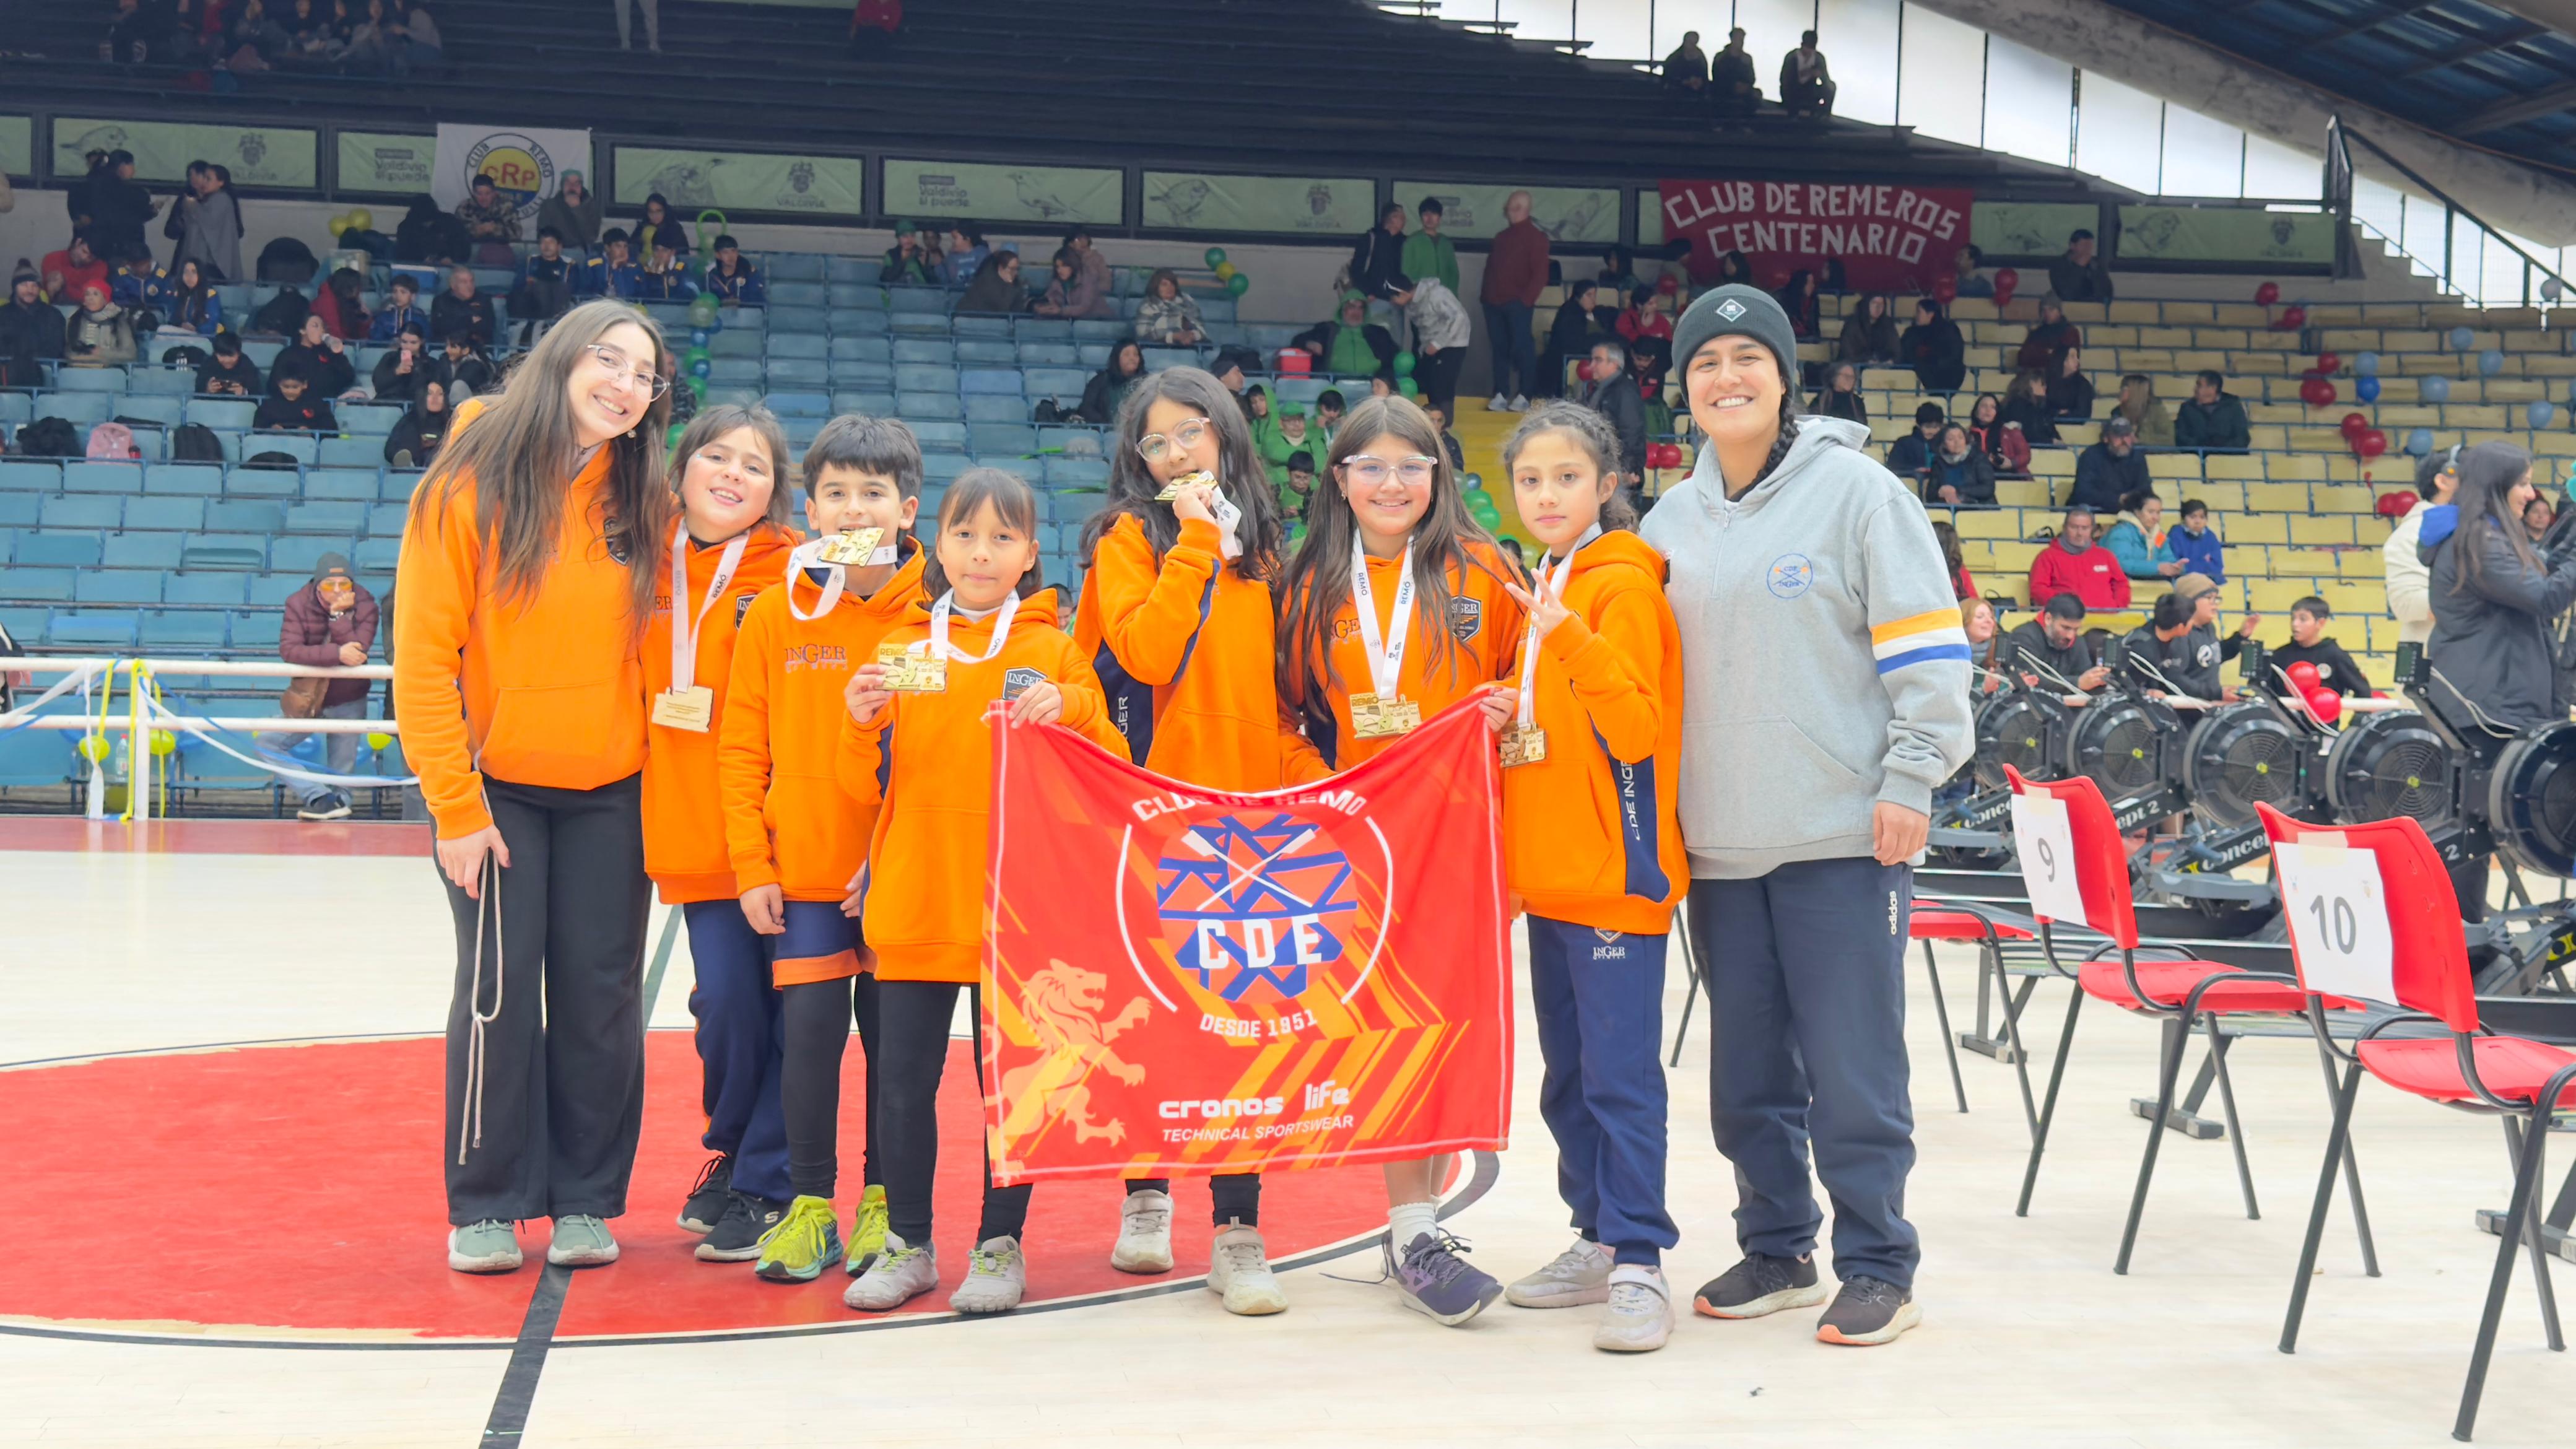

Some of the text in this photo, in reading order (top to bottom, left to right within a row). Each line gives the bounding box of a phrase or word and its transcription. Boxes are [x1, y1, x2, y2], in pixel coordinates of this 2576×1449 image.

[468, 142, 490, 168] CLUB
[484, 162, 536, 186] CRP
[1664, 182, 1962, 241] CLUB DE REMEROS
[1707, 220, 1928, 265] CENTENARIO
[785, 643, 846, 663] INGER
[1351, 696, 1379, 707] REMO
[2147, 800, 2160, 816] 2
[2037, 837, 2055, 882] 9
[2445, 843, 2461, 861] 2
[1888, 890, 1898, 935] adidas
[2310, 895, 2357, 955] 10
[1197, 913, 1323, 969] CDE
[1593, 946, 1625, 957] INGER
[1199, 1009, 1318, 1038] DESDE 1951
[1159, 1096, 1284, 1118] cronos
[1162, 1115, 1354, 1142] TECHNICAL SPORTSWEAR
